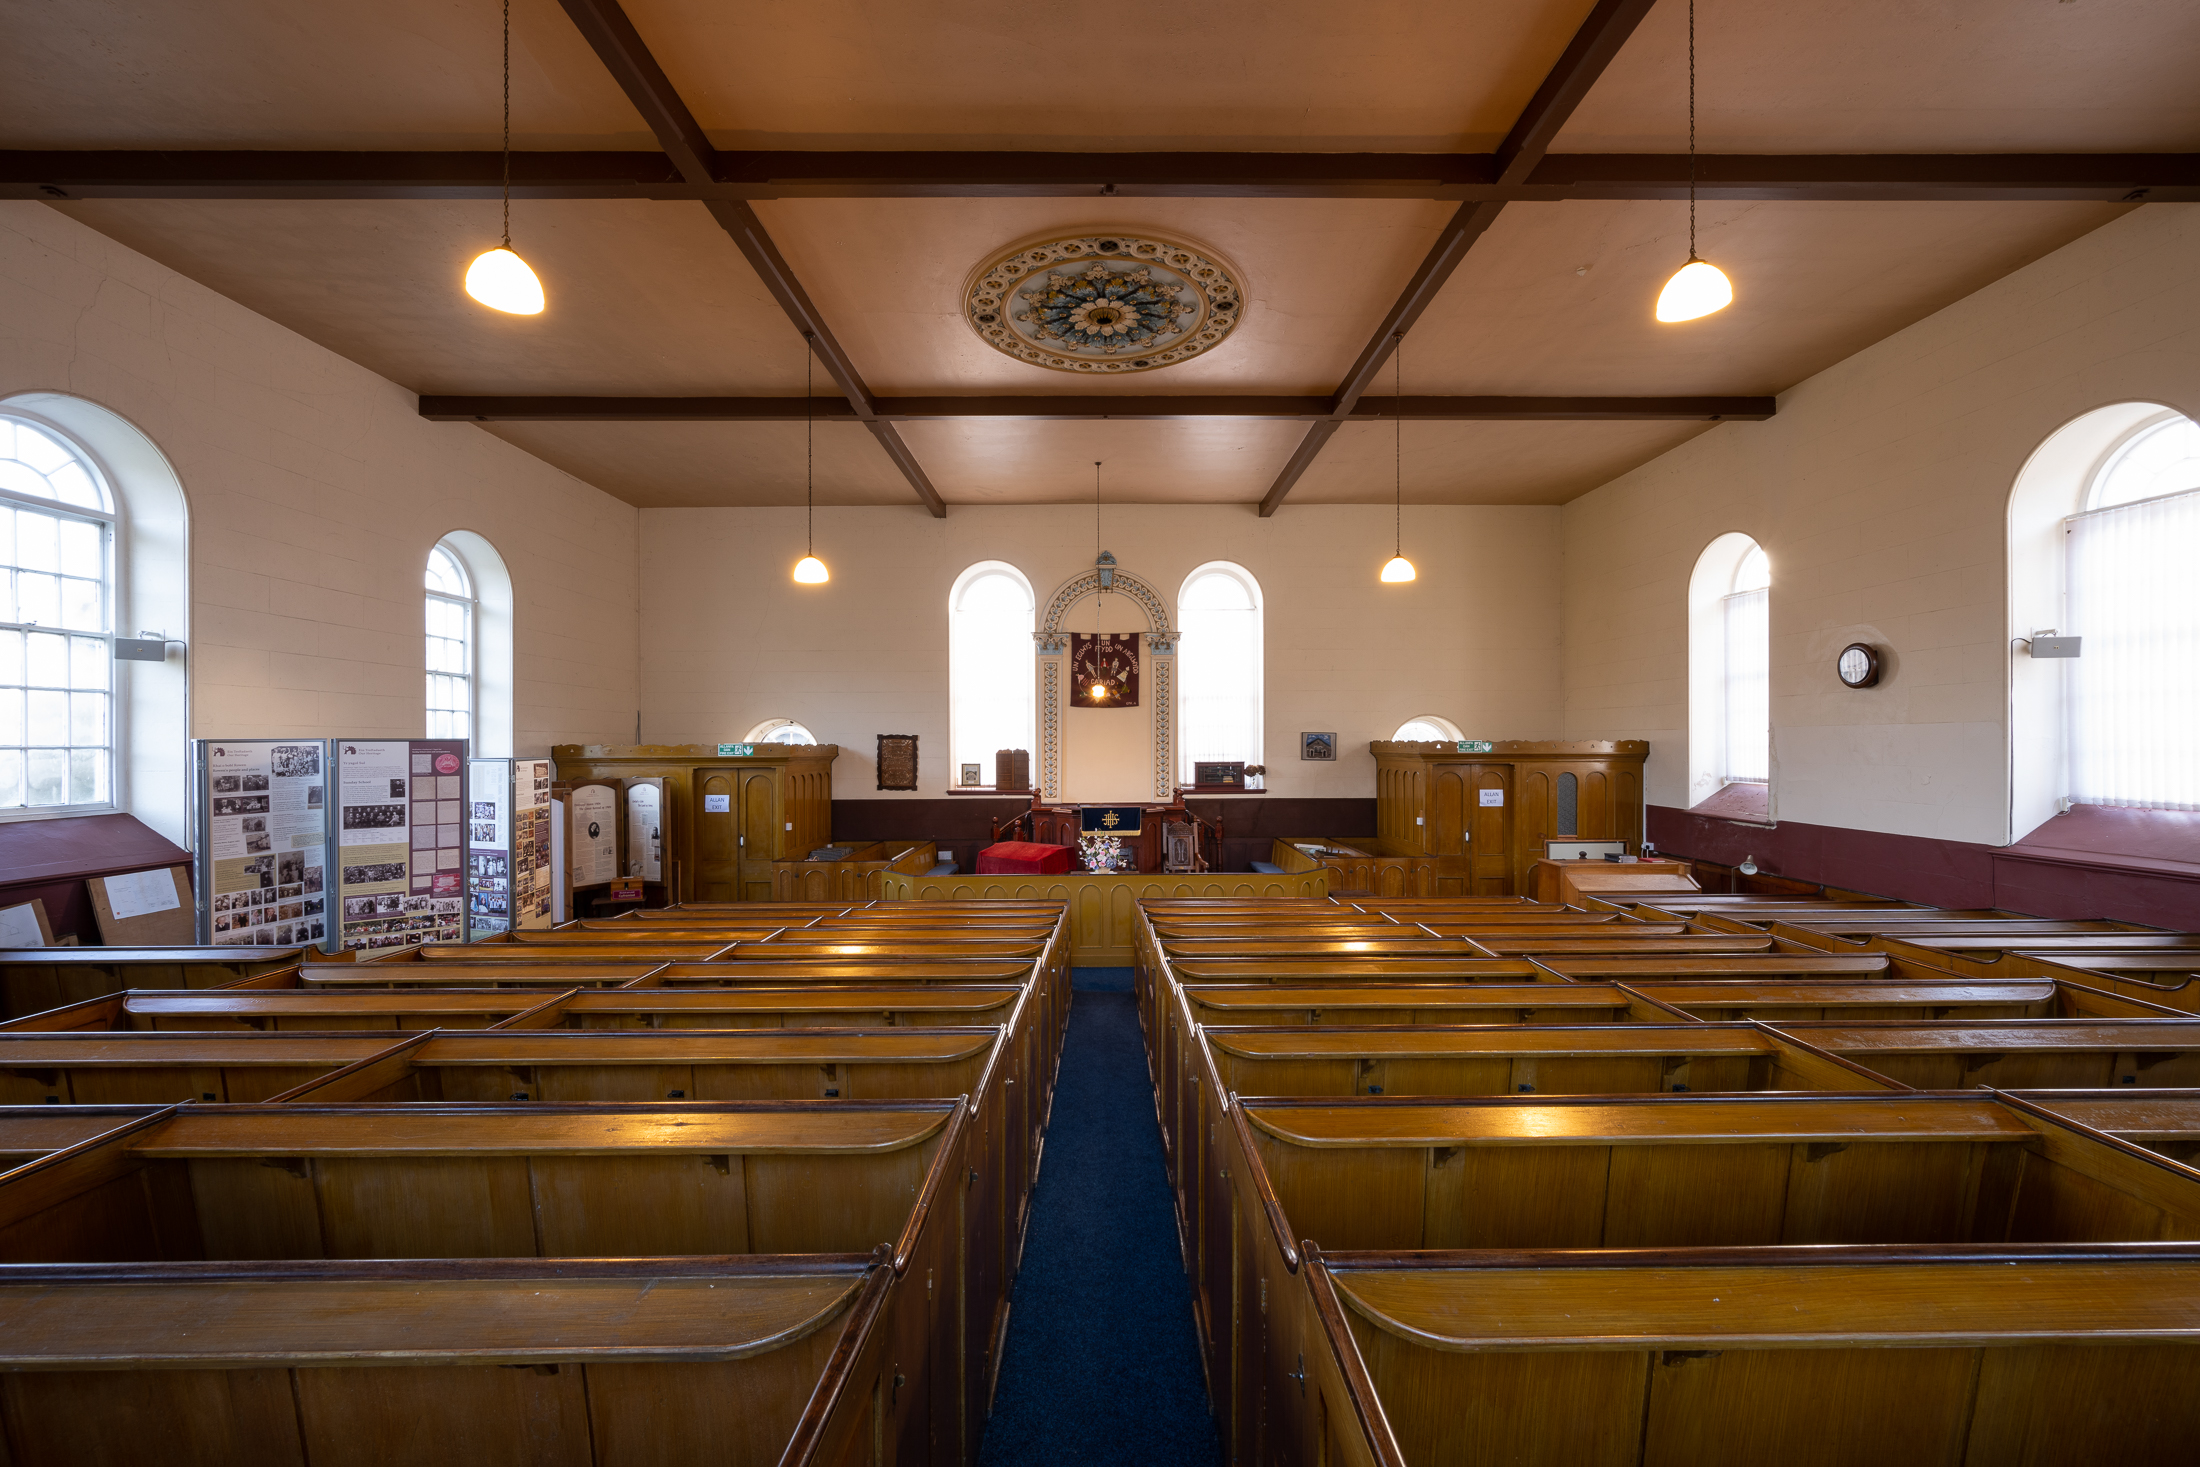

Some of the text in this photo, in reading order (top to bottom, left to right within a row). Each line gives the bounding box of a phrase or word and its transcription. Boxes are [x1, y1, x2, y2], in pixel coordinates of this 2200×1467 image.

[1072, 642, 1092, 672] UN EGLWYS
[1115, 644, 1123, 652] UN
